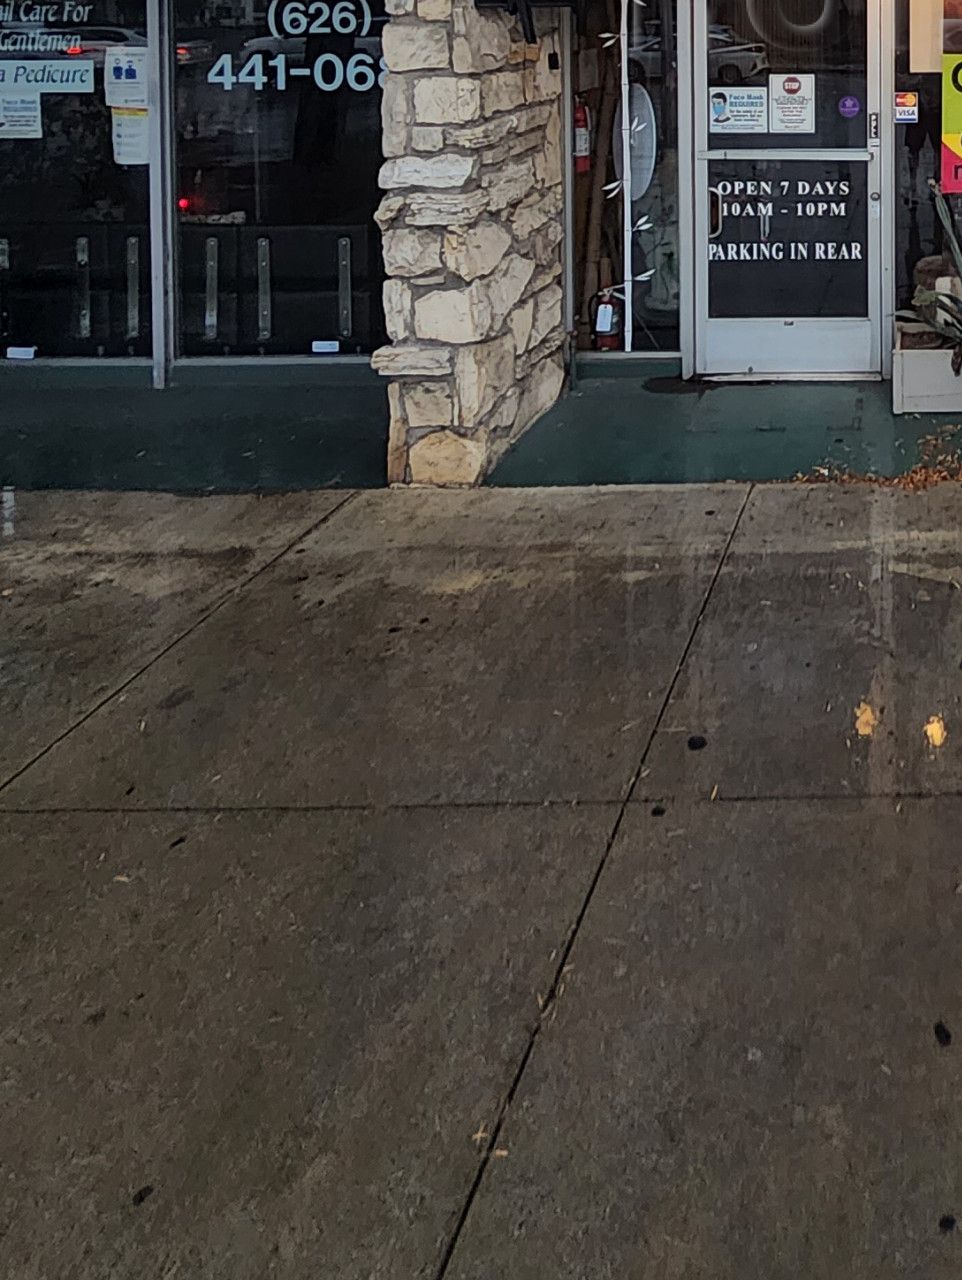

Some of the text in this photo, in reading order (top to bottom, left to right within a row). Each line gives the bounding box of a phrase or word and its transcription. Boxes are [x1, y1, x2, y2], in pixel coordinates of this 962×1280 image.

[20, 0, 59, 22] Care
[63, 0, 94, 22] For
[0, 30, 81, 52] Gentlemen
[14, 64, 90, 84] Pedicure
[897, 109, 916, 117] VISA
[717, 181, 850, 195] OPEN 7 DAYS
[722, 202, 774, 216] 10AM
[796, 202, 847, 216] 10PM
[708, 242, 863, 261] PARKING IN REAR
